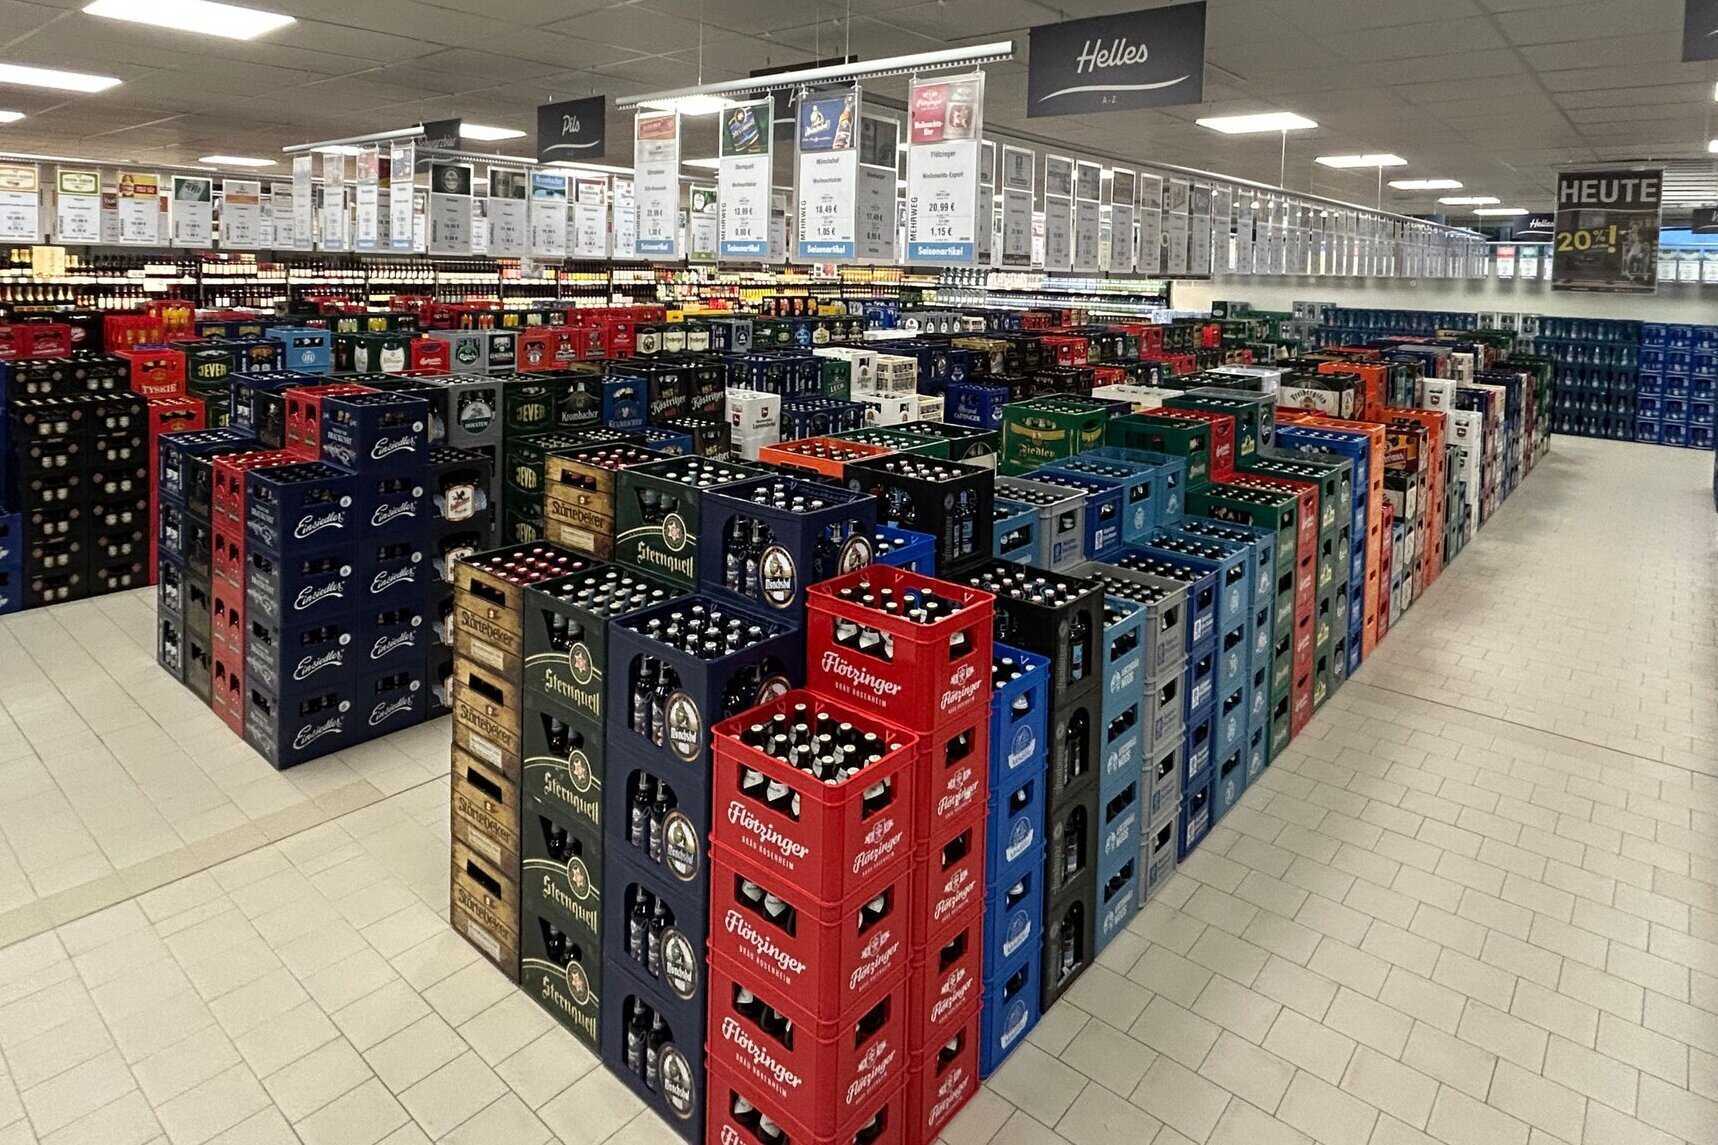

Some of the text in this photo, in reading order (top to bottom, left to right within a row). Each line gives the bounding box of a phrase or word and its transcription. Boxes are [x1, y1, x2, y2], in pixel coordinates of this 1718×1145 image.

[1076, 38, 1148, 74] Helles
[562, 115, 580, 136] Pils
[1560, 178, 1659, 203] HEUTE
[833, 205, 837, 213] €
[910, 197, 918, 241] MEHRWEG
[928, 202, 955, 213] 20,99 €
[947, 227, 952, 235] €
[807, 244, 845, 254] Saisonartikel
[917, 245, 963, 256] Saisonartikel
[198, 363, 227, 378] JEVER
[141, 383, 177, 394] TYSKIE
[691, 391, 725, 411] Köstritzer
[516, 403, 545, 422] JEVER
[561, 409, 599, 422] Krombacher
[650, 395, 686, 416] Köstritzer
[371, 435, 417, 460] Einsiedler
[515, 468, 537, 488] JEVER
[294, 510, 346, 539] Einsiedler
[371, 499, 417, 527] Einsiedler
[551, 500, 605, 529] Störtebeker
[515, 522, 537, 542] JEVER
[638, 541, 694, 578] Sternquell
[293, 579, 345, 611] Einsiedler
[370, 565, 417, 594] Einsiedler
[370, 630, 417, 660] Einsiedler
[461, 610, 515, 648] Störtebeker
[293, 647, 345, 681] Einsiedler
[821, 650, 902, 696] Flötzinger
[545, 668, 600, 717] Sternquell
[940, 679, 981, 710] Flötzinger
[368, 694, 416, 727] Einsiedler
[460, 702, 511, 745] Störtebeker
[292, 716, 344, 750] Einsiedler
[544, 771, 599, 825] Sternquell
[938, 780, 979, 816] Flötzinger
[459, 796, 511, 841] Störtebeker
[728, 800, 809, 859] Flötzinger
[758, 845, 794, 871] ROSENHEIM
[852, 830, 903, 874] Flötzinger
[542, 875, 598, 934] Sternquell
[934, 879, 976, 921] Flötzinger
[724, 908, 806, 976] Flötzinger
[849, 940, 900, 990] Flötzinger
[541, 978, 597, 1040] Sternquell
[930, 977, 973, 1023] Flötzinger
[721, 1016, 802, 1088] Flötzinger
[845, 1048, 896, 1105] Flötzinger
[929, 1075, 970, 1127] Flötzinger
